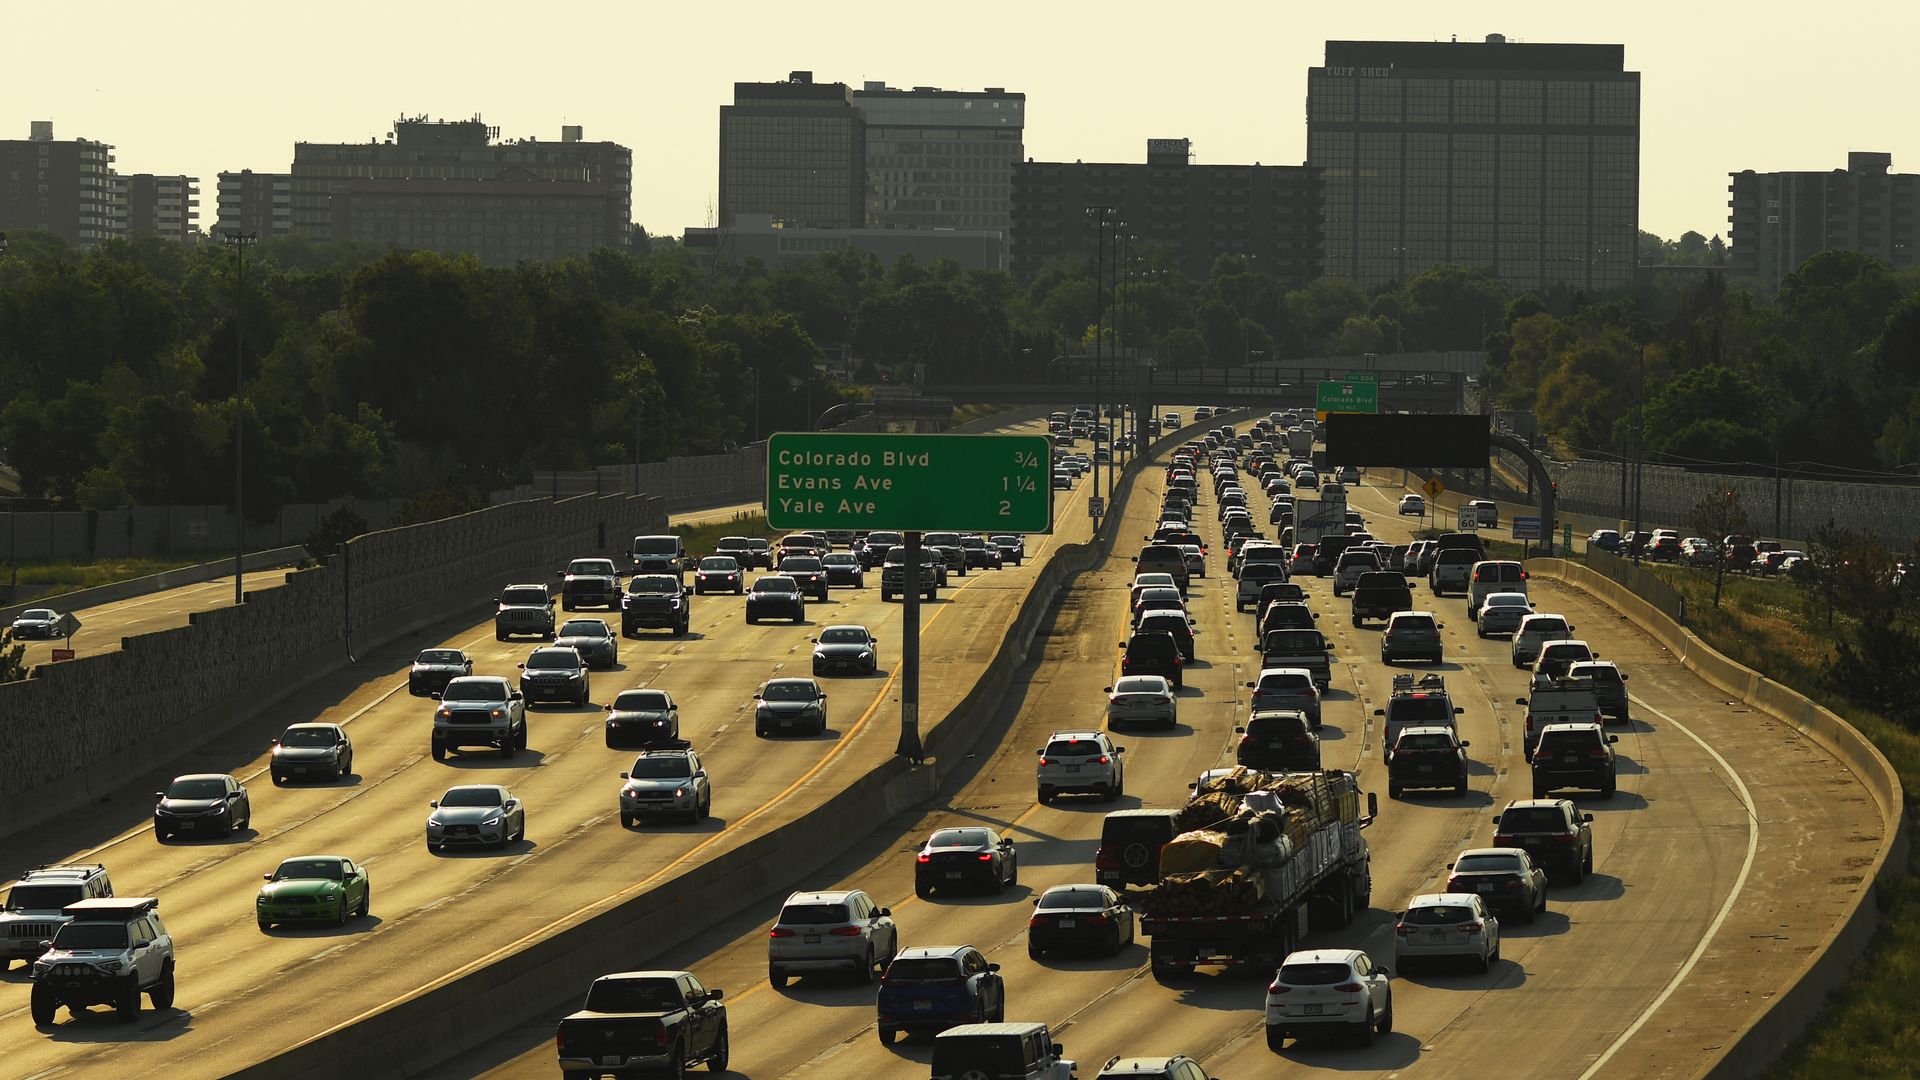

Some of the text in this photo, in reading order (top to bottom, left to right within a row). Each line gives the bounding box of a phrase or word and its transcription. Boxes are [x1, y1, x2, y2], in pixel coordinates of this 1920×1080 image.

[1326, 66, 1389, 77] TUFF SHED
[1322, 395, 1354, 403] Colorado
[778, 450, 872, 467] Colorado
[882, 450, 930, 468] Blvd
[778, 474, 842, 490] Evans
[853, 474, 894, 491] Ave
[779, 497, 1012, 516] Yale Ave 2
[1090, 508, 1103, 516] 60
[1461, 519, 1475, 528] 60
